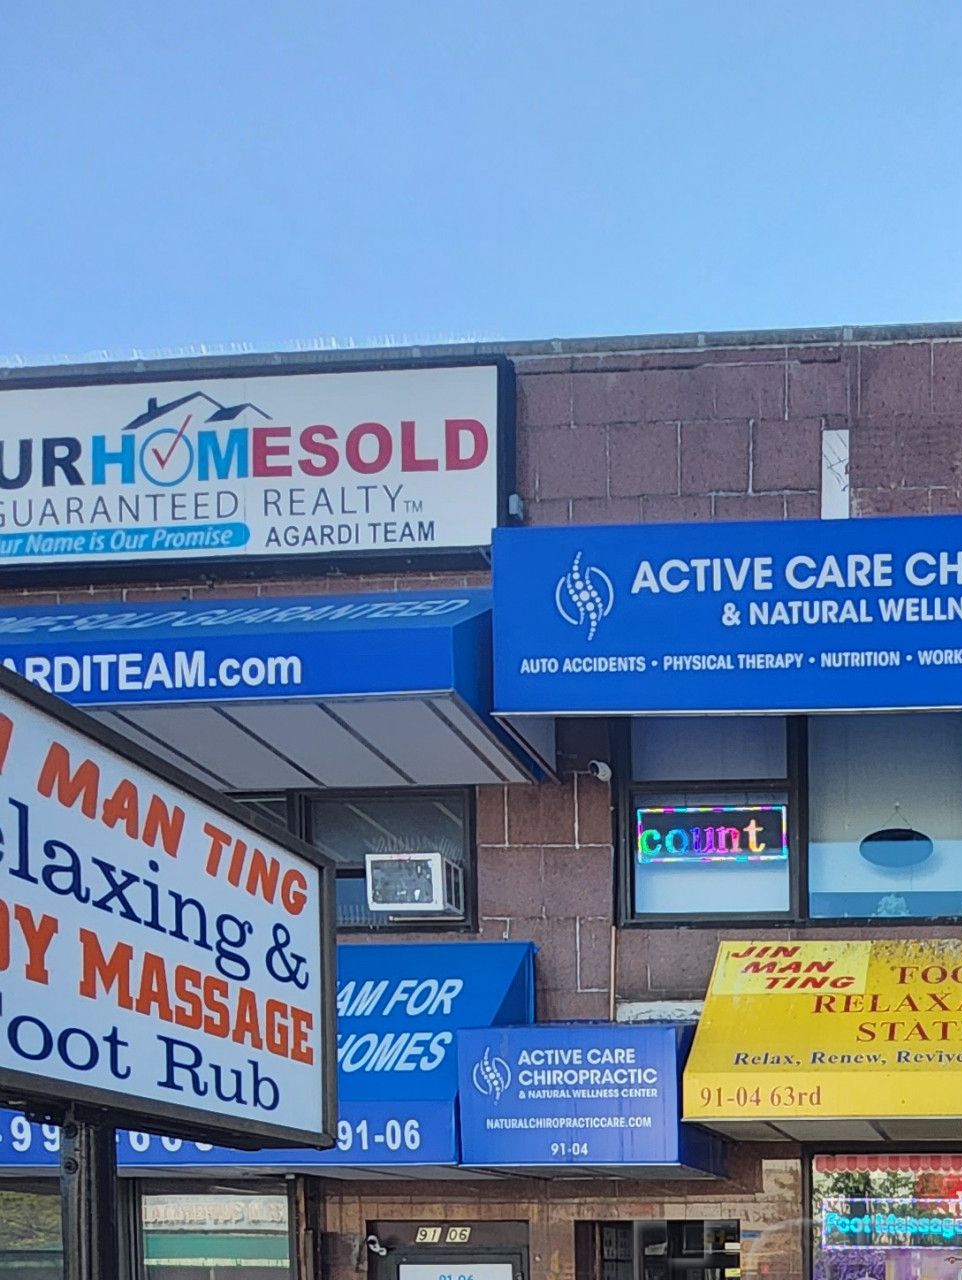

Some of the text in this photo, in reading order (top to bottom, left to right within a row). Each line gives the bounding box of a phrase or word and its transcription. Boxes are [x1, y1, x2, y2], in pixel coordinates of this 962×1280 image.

[265, 484, 403, 516] REALTY
[26, 527, 233, 553] Name is Our Promise
[265, 521, 435, 548] AGARDI TEAM
[631, 557, 772, 594] ACTIVE
[785, 554, 892, 589] CARE
[172, 599, 471, 628] GUARANTEED
[721, 602, 741, 626] &
[749, 599, 872, 625] NATURAL
[520, 657, 558, 674] AUTO
[562, 656, 646, 673] ACCIDENTS
[663, 654, 734, 671] PHYSICAL
[737, 653, 803, 669] THERAPY
[821, 651, 900, 667] NUTRITION
[37, 740, 186, 858] MAN
[203, 822, 307, 917] TING
[639, 819, 766, 855] count
[0, 798, 309, 990] laxing &
[731, 946, 800, 958] JIN
[741, 961, 834, 973] MAN
[765, 976, 855, 989] TING
[79, 928, 315, 1066] MASSAGE
[382, 979, 463, 1016] FOR
[0, 1006, 281, 1111] oot Rub
[518, 1048, 636, 1065] ACTIVE CARE
[733, 1049, 801, 1067] Relax,
[810, 1049, 887, 1066] Renew,
[518, 1068, 658, 1086] CHIROPRACTIC
[518, 1088, 658, 1100] & NATURAL WELLNESS CENTER
[700, 1086, 761, 1107] 91-04
[769, 1085, 821, 1107] 63rd
[337, 1119, 420, 1151] 91-06
[486, 1116, 652, 1130] NATURALCHIROPRACTICCARE.COM
[550, 1142, 588, 1156] 91-04
[418, 1229, 468, 1241] 91 06
[825, 1213, 872, 1233] Foot
